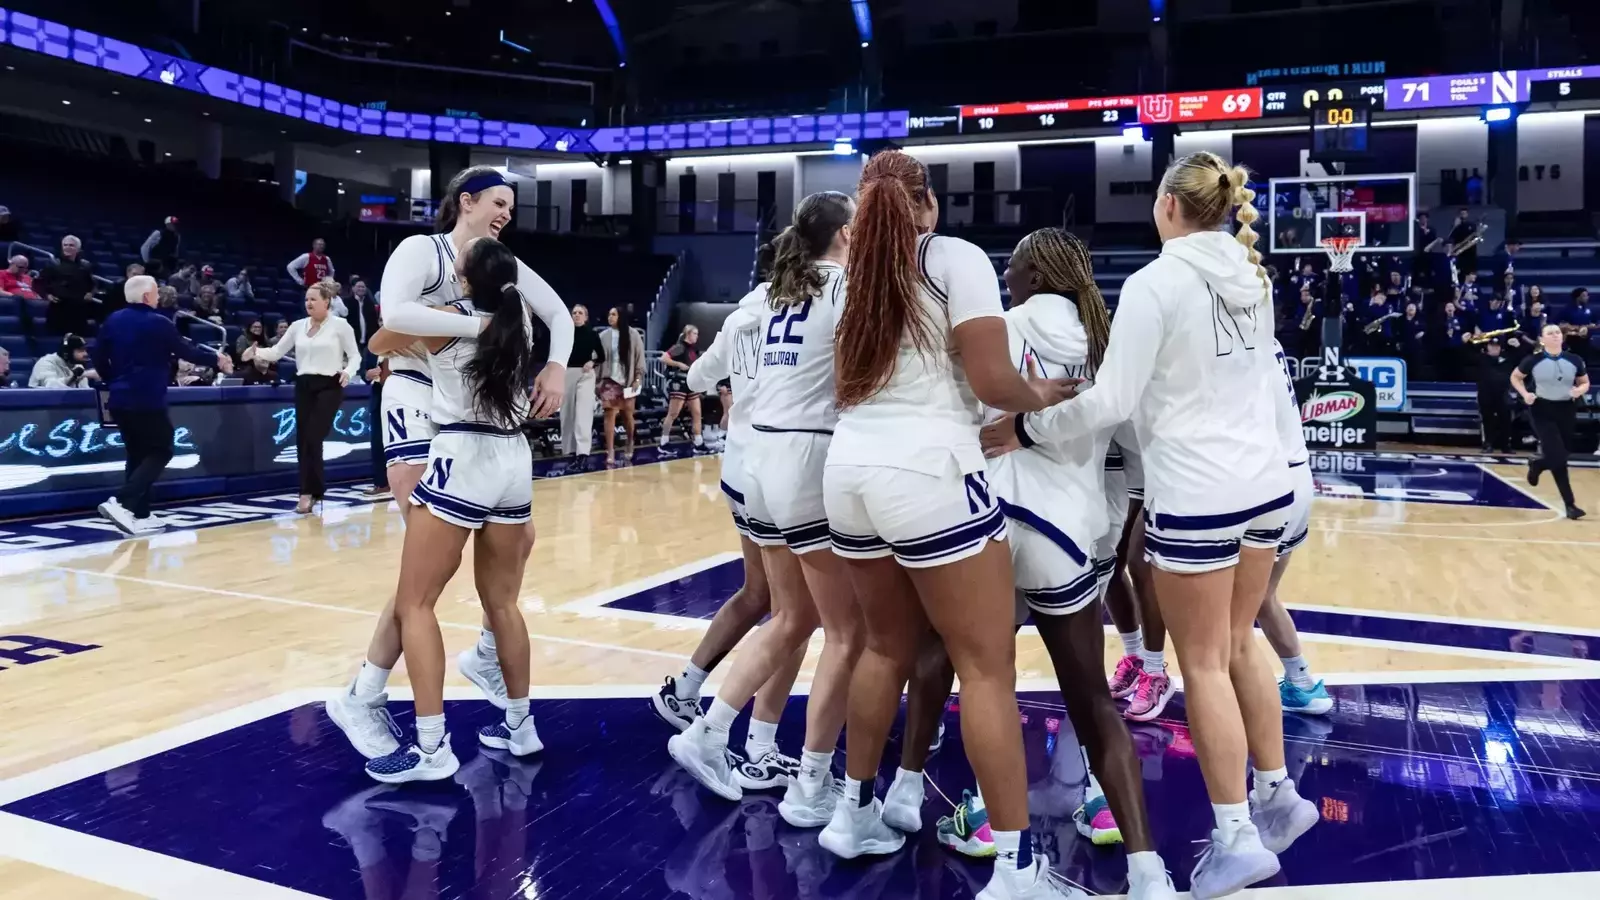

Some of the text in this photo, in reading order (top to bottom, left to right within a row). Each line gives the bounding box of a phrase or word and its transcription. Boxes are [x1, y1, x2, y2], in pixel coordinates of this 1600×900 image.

[1547, 69, 1582, 79] STEALS
[1451, 78, 1478, 87] FOULS
[1492, 70, 1518, 103] N
[1559, 82, 1571, 96] 5
[1266, 92, 1287, 102] QTR
[1361, 85, 1384, 96] POSS
[1402, 82, 1430, 102] 71
[1026, 102, 1069, 112] TURNOVERS
[1222, 93, 1252, 113] 69
[1266, 102, 1285, 111] 4TH
[978, 117, 994, 129] 10
[1039, 114, 1055, 126] 16
[1103, 110, 1119, 122] 23
[766, 295, 810, 345] 22
[763, 351, 799, 367] SULLIVAN
[1325, 346, 1340, 366] N
[1301, 396, 1359, 422] LIBMAN
[387, 408, 408, 443] N
[427, 457, 454, 490] N
[964, 470, 991, 515] N
